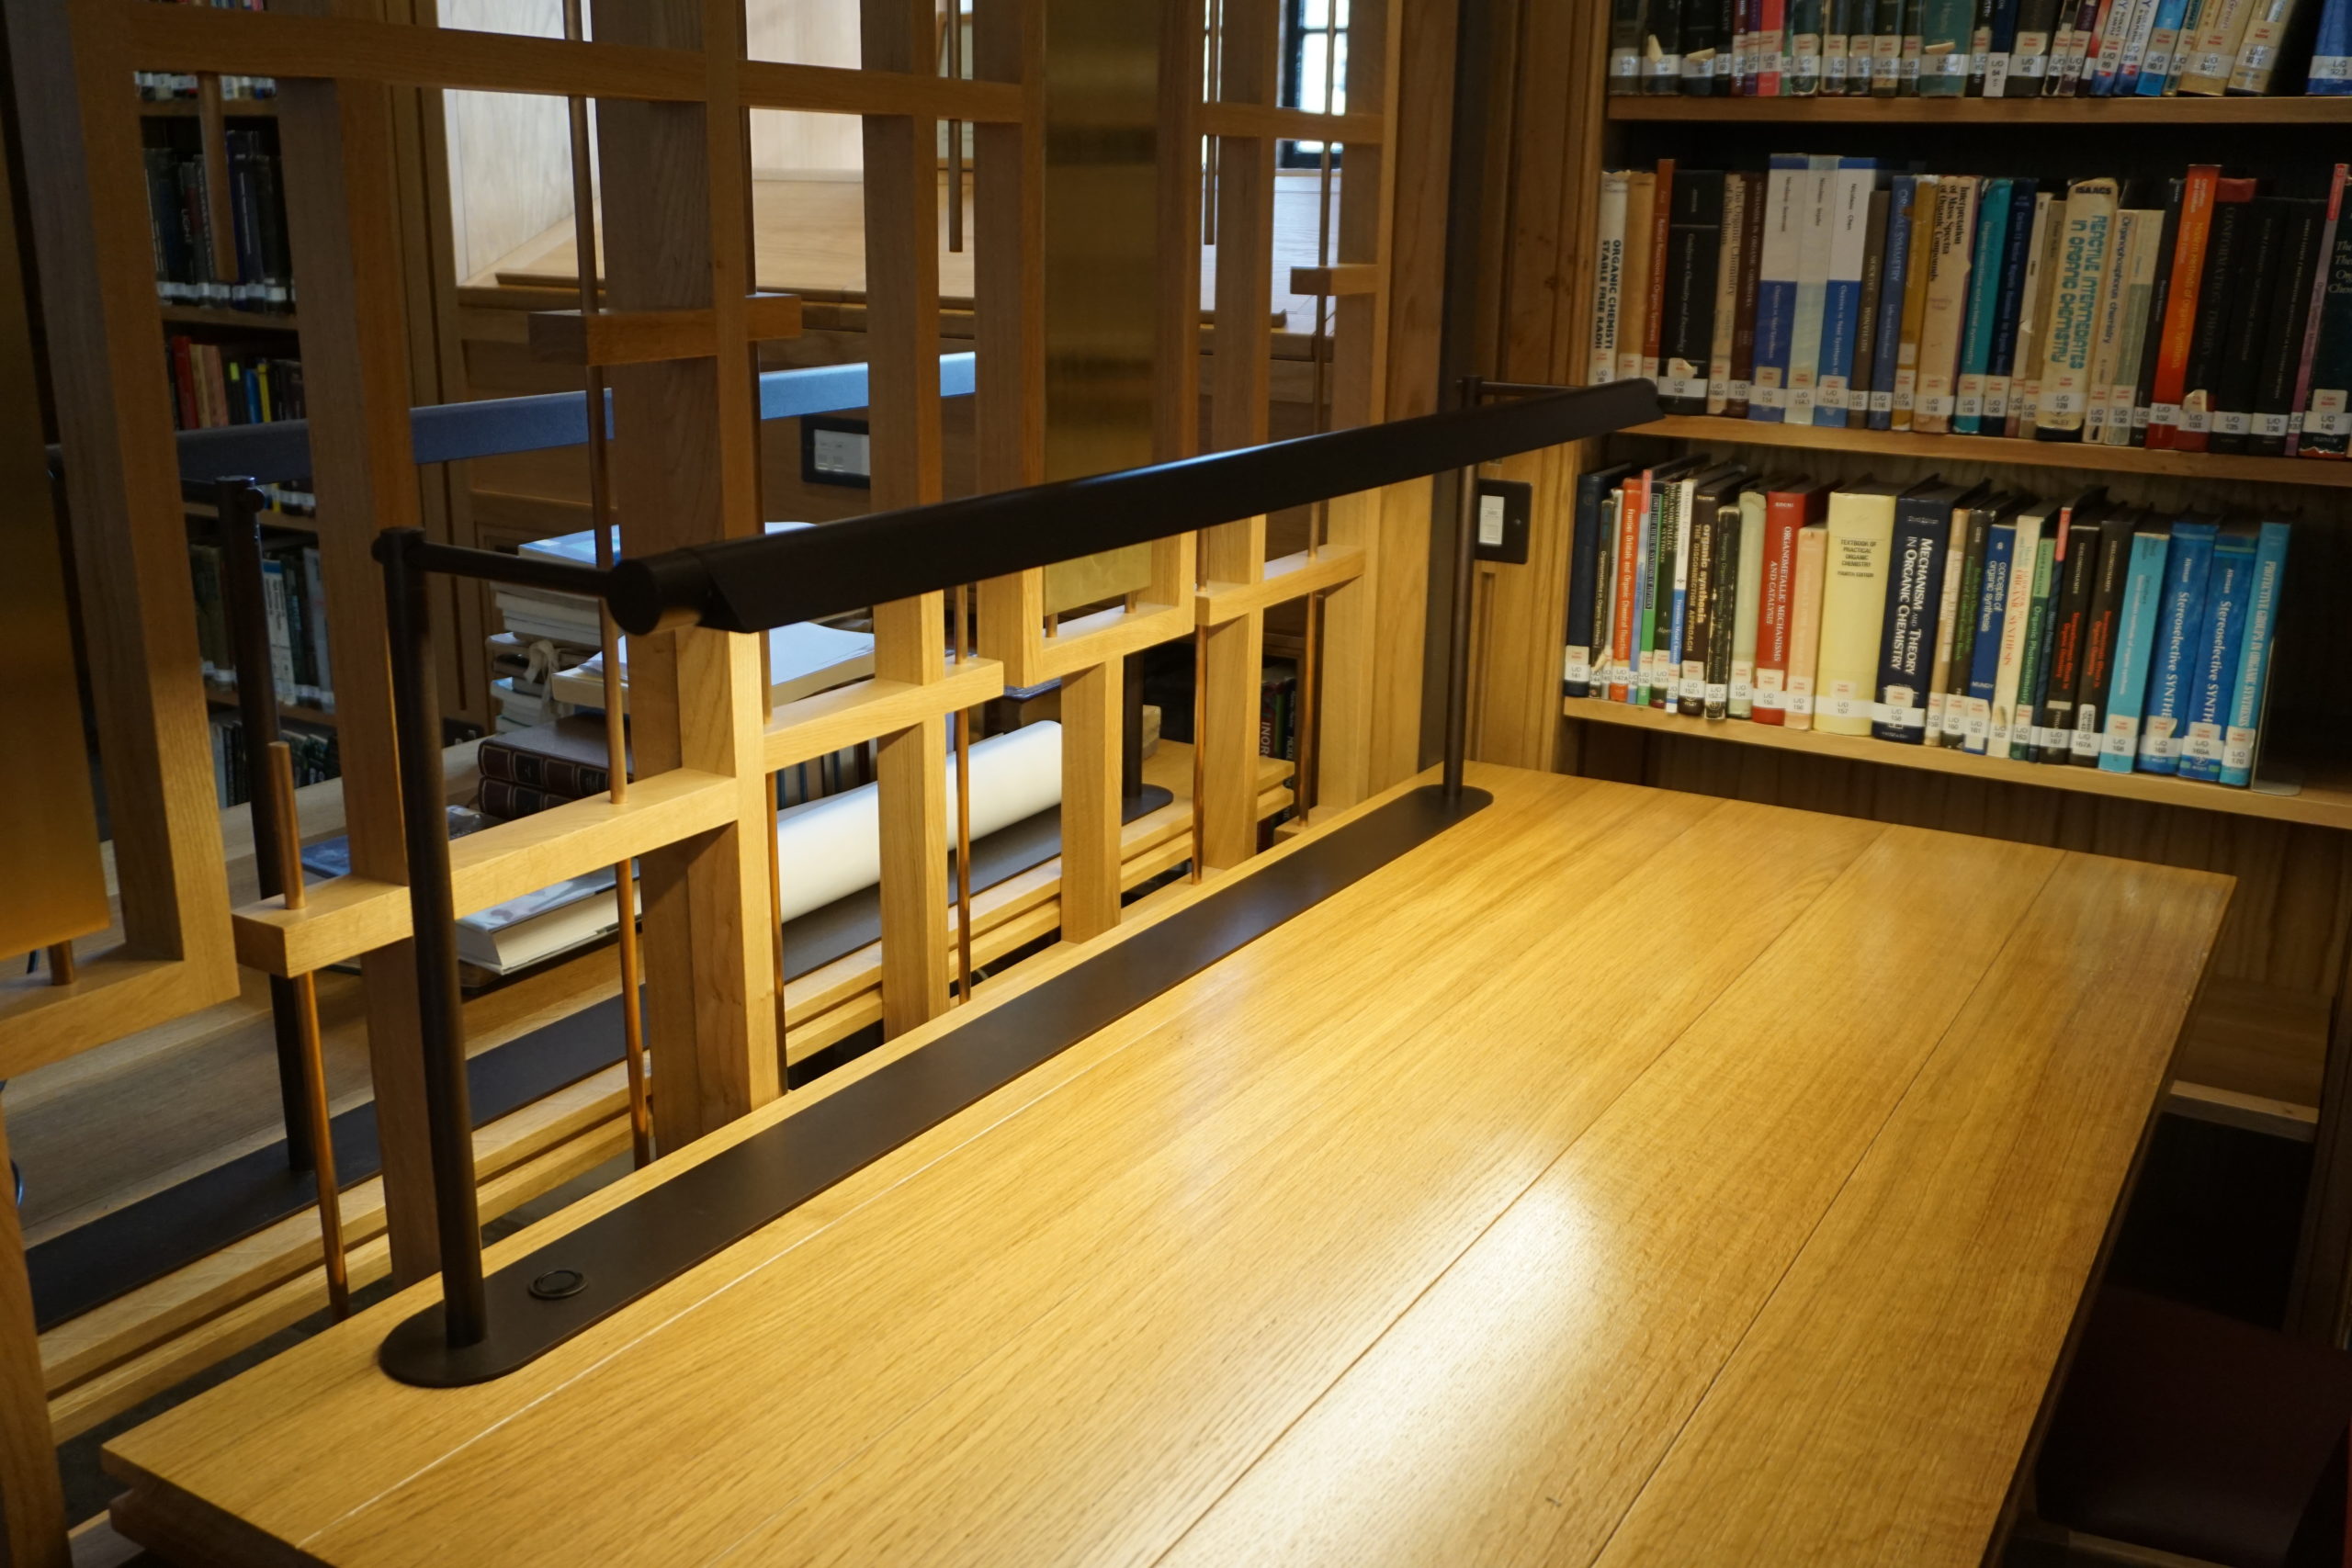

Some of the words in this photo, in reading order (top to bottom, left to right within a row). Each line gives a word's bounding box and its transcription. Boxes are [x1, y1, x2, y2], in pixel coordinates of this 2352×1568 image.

[1939, 185, 1949, 194] of
[1948, 197, 1958, 220] Mass
[1950, 185, 1959, 194] of
[1936, 196, 1948, 228] Organic
[1955, 186, 1969, 244] Interpretation
[1929, 231, 1943, 281] Compounds
[1942, 222, 1955, 254] Spectra
[2110, 217, 2131, 299] Organophosphorus
[1600, 240, 1610, 282] STABLE
[1609, 240, 1622, 294] ORGANIC
[1598, 287, 1606, 313] FREE
[1594, 317, 1604, 349] RADI
[1605, 297, 1618, 349] CHEMIST
[2103, 302, 2118, 344] chemistry
[1626, 509, 1634, 533] Frontier
[1905, 536, 1917, 547] IN
[1624, 536, 1633, 558] Orbitals
[1700, 525, 1711, 568] organic
[1779, 526, 1792, 603] ORGANOMETALLIC
[1621, 575, 1631, 598] Organic
[1689, 543, 1700, 607] DISCONNECTION
[1770, 560, 1778, 580] AND
[1899, 549, 1917, 603] ORGANIC
[1913, 538, 1934, 610] MECHANISM
[1985, 560, 1997, 592] organic
[1994, 562, 2007, 601] concepts
[2257, 561, 2277, 608] PROTECTIVE
[1621, 600, 1630, 627] Chemical
[1697, 571, 1709, 624] synthesis
[1766, 581, 1777, 625] CATALYSIS
[1981, 593, 1993, 632] synthesis
[1995, 603, 2003, 612] of
[1686, 610, 1695, 652] APPROACH
[1773, 605, 1784, 661] MECHANISMS
[1890, 604, 1910, 670] CHEMISTRY
[2030, 606, 2042, 639] Organic
[2168, 592, 2188, 671] Stereoselective
[2209, 601, 2231, 681] Stereoselective
[2253, 611, 2267, 640] GROUPS
[1905, 628, 1922, 674] THEORY
[2245, 651, 2260, 683] ORGANIC
[2251, 642, 2260, 650] IN
[2020, 641, 2038, 704] Photochemistry
[2161, 674, 2177, 717] SYNTHE
[2202, 683, 2218, 723] SYNTH
[2239, 685, 2255, 727] SYNTHESIS
